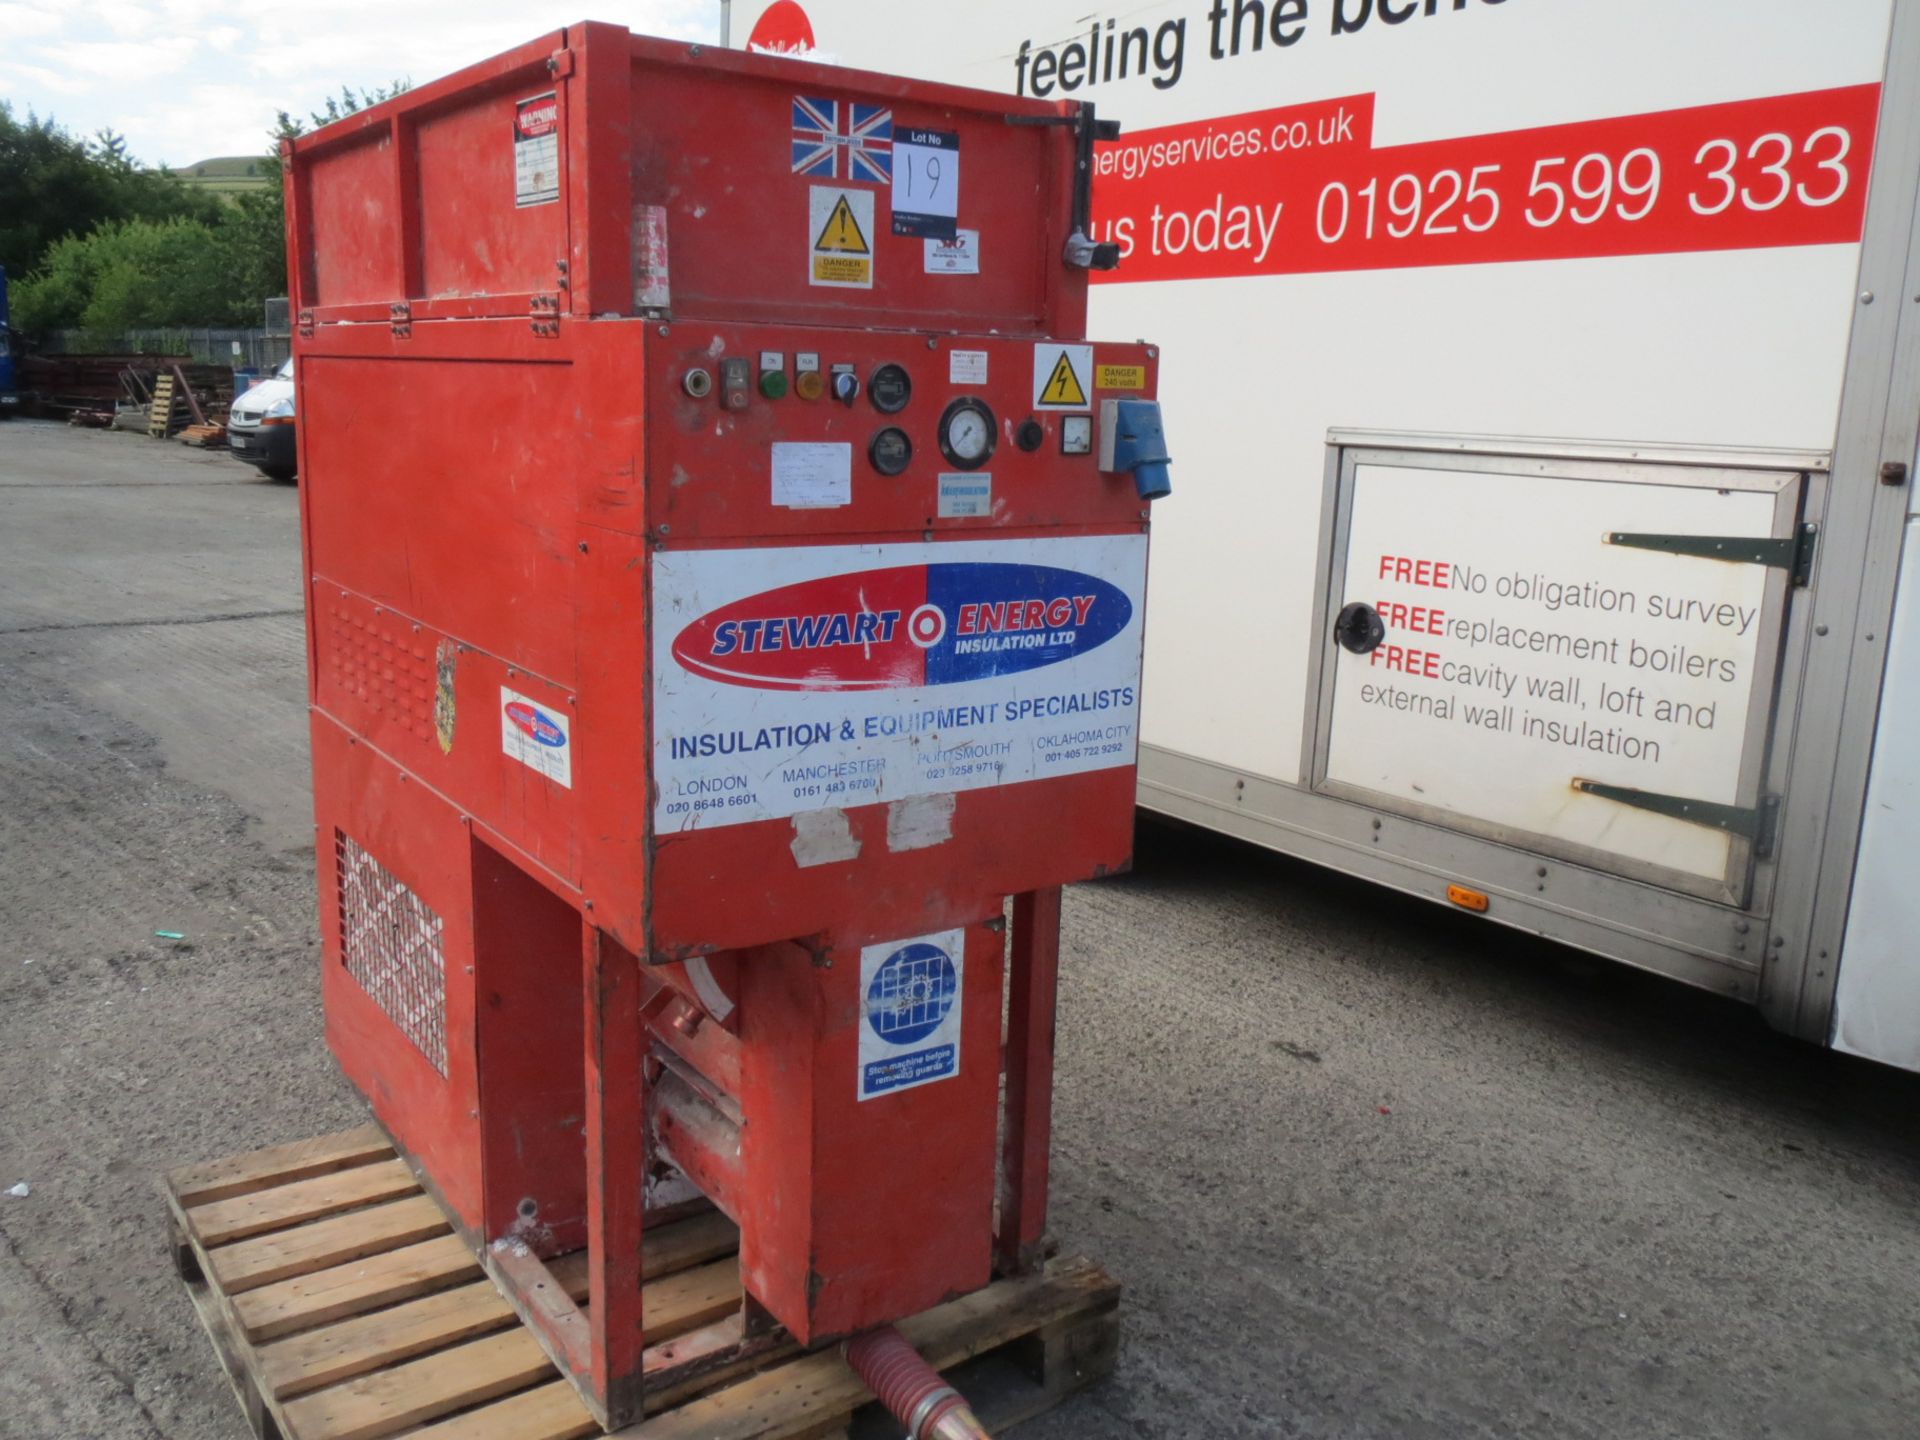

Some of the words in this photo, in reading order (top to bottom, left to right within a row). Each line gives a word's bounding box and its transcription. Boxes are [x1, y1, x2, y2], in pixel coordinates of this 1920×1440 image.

[1014, 17, 1187, 97] feeling
[1208, 0, 1308, 60] the
[911, 131, 927, 142] Lot
[928, 134, 942, 145] No
[907, 153, 941, 199] 19
[1150, 193, 1283, 264] today
[1316, 165, 1501, 244] 01925
[1524, 148, 1663, 229] 599
[1687, 126, 1852, 215] 333
[823, 258, 861, 268] DANGER
[1104, 368, 1137, 378] DANGER
[1379, 555, 1450, 590] FREE
[1450, 563, 1487, 595] No
[1495, 571, 1636, 613] obligation
[1647, 593, 1757, 636] survey
[710, 610, 901, 656] STEWART
[954, 595, 1097, 636] ENERGY
[954, 634, 1047, 656] INSULATION
[1048, 631, 1077, 648] LTD
[1375, 600, 1445, 636] FREE
[1445, 615, 1618, 665] replacement
[1628, 638, 1737, 683] boilers
[1369, 643, 1440, 680] FREE
[1441, 659, 1518, 699] cavity
[1526, 671, 1588, 710] wall,
[1599, 681, 1644, 718] loft
[1654, 693, 1717, 730] and
[671, 721, 831, 760] INSULATION
[840, 719, 855, 740] &
[864, 703, 999, 738] EQUIPMENT
[1005, 687, 1134, 722] SPECIALISTS
[1360, 681, 1455, 721] external
[1463, 701, 1513, 733] wall
[1522, 710, 1661, 763] insulation
[1037, 729, 1104, 749] OKLAHOMA
[1105, 725, 1132, 740] CITY
[1045, 753, 1061, 763] 001
[1064, 750, 1081, 760] 405
[1084, 747, 1100, 757] 722
[1101, 743, 1123, 755] 9292
[782, 758, 887, 783] MANCHESTER
[677, 775, 748, 796] LONDON
[793, 785, 821, 799] 0161
[825, 780, 846, 793] 483
[666, 802, 690, 815] 020
[693, 797, 724, 811] 8648
[728, 793, 758, 807] 6601
[868, 1065, 889, 1077] Stop
[889, 1056, 924, 1072] machine
[925, 1049, 951, 1063] before
[876, 1069, 914, 1085] removing
[915, 1062, 943, 1077] guards
